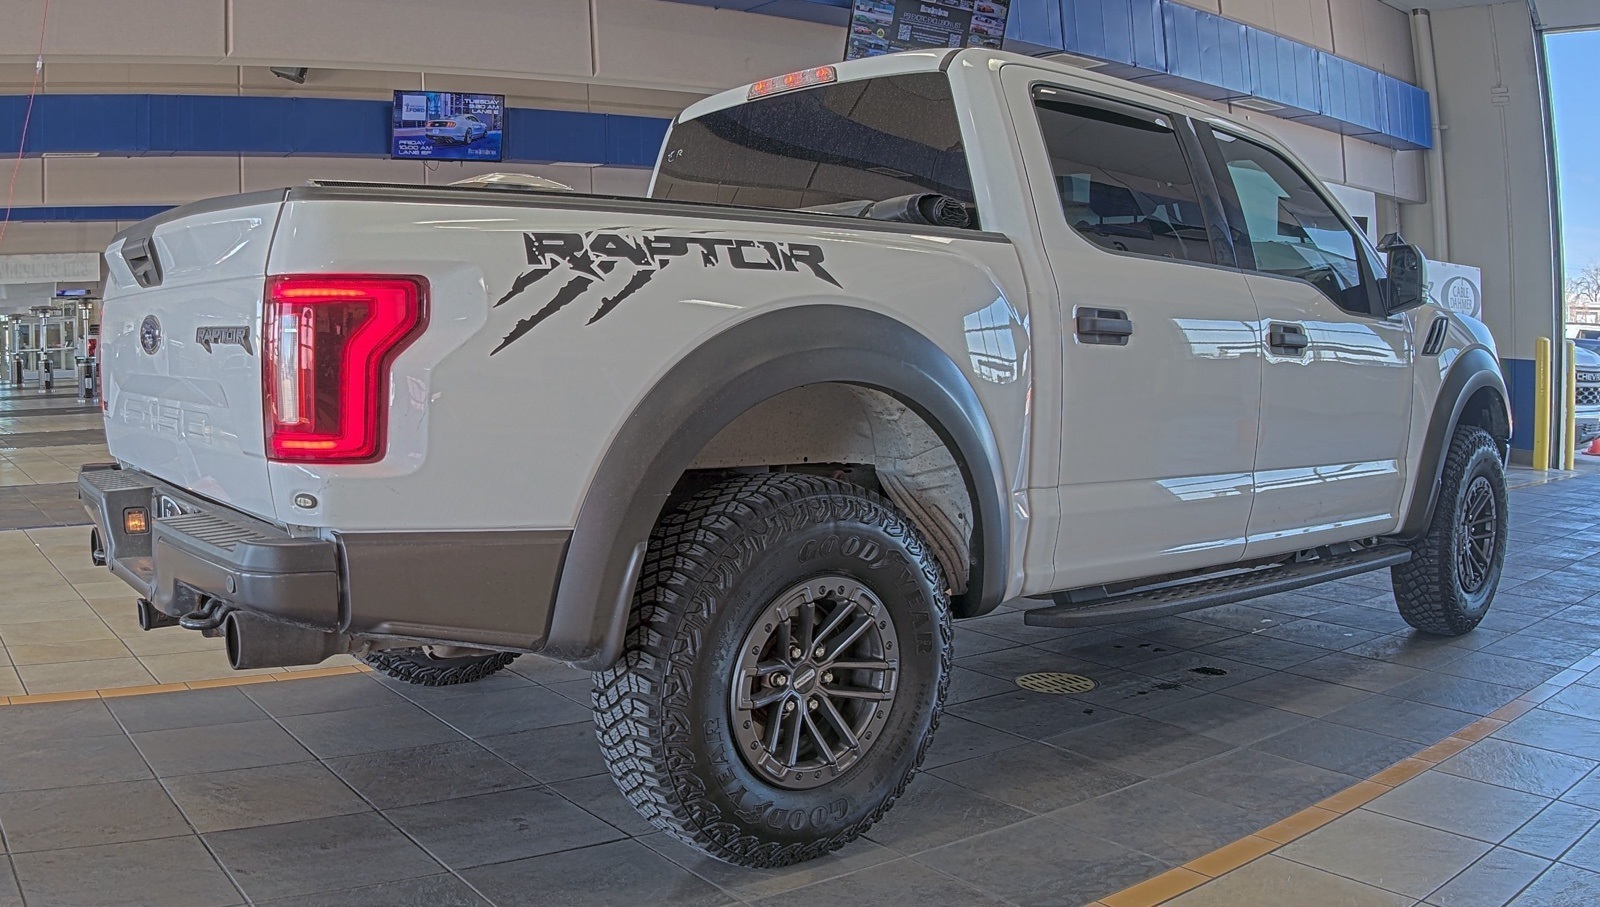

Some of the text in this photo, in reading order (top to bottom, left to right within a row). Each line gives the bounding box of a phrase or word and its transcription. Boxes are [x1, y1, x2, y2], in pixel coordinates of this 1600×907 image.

[523, 230, 844, 290] RAPTOR
[1450, 297, 1473, 310] DAHMER
[1452, 286, 1469, 299] CABLE
[195, 325, 254, 356] RAPTOR
